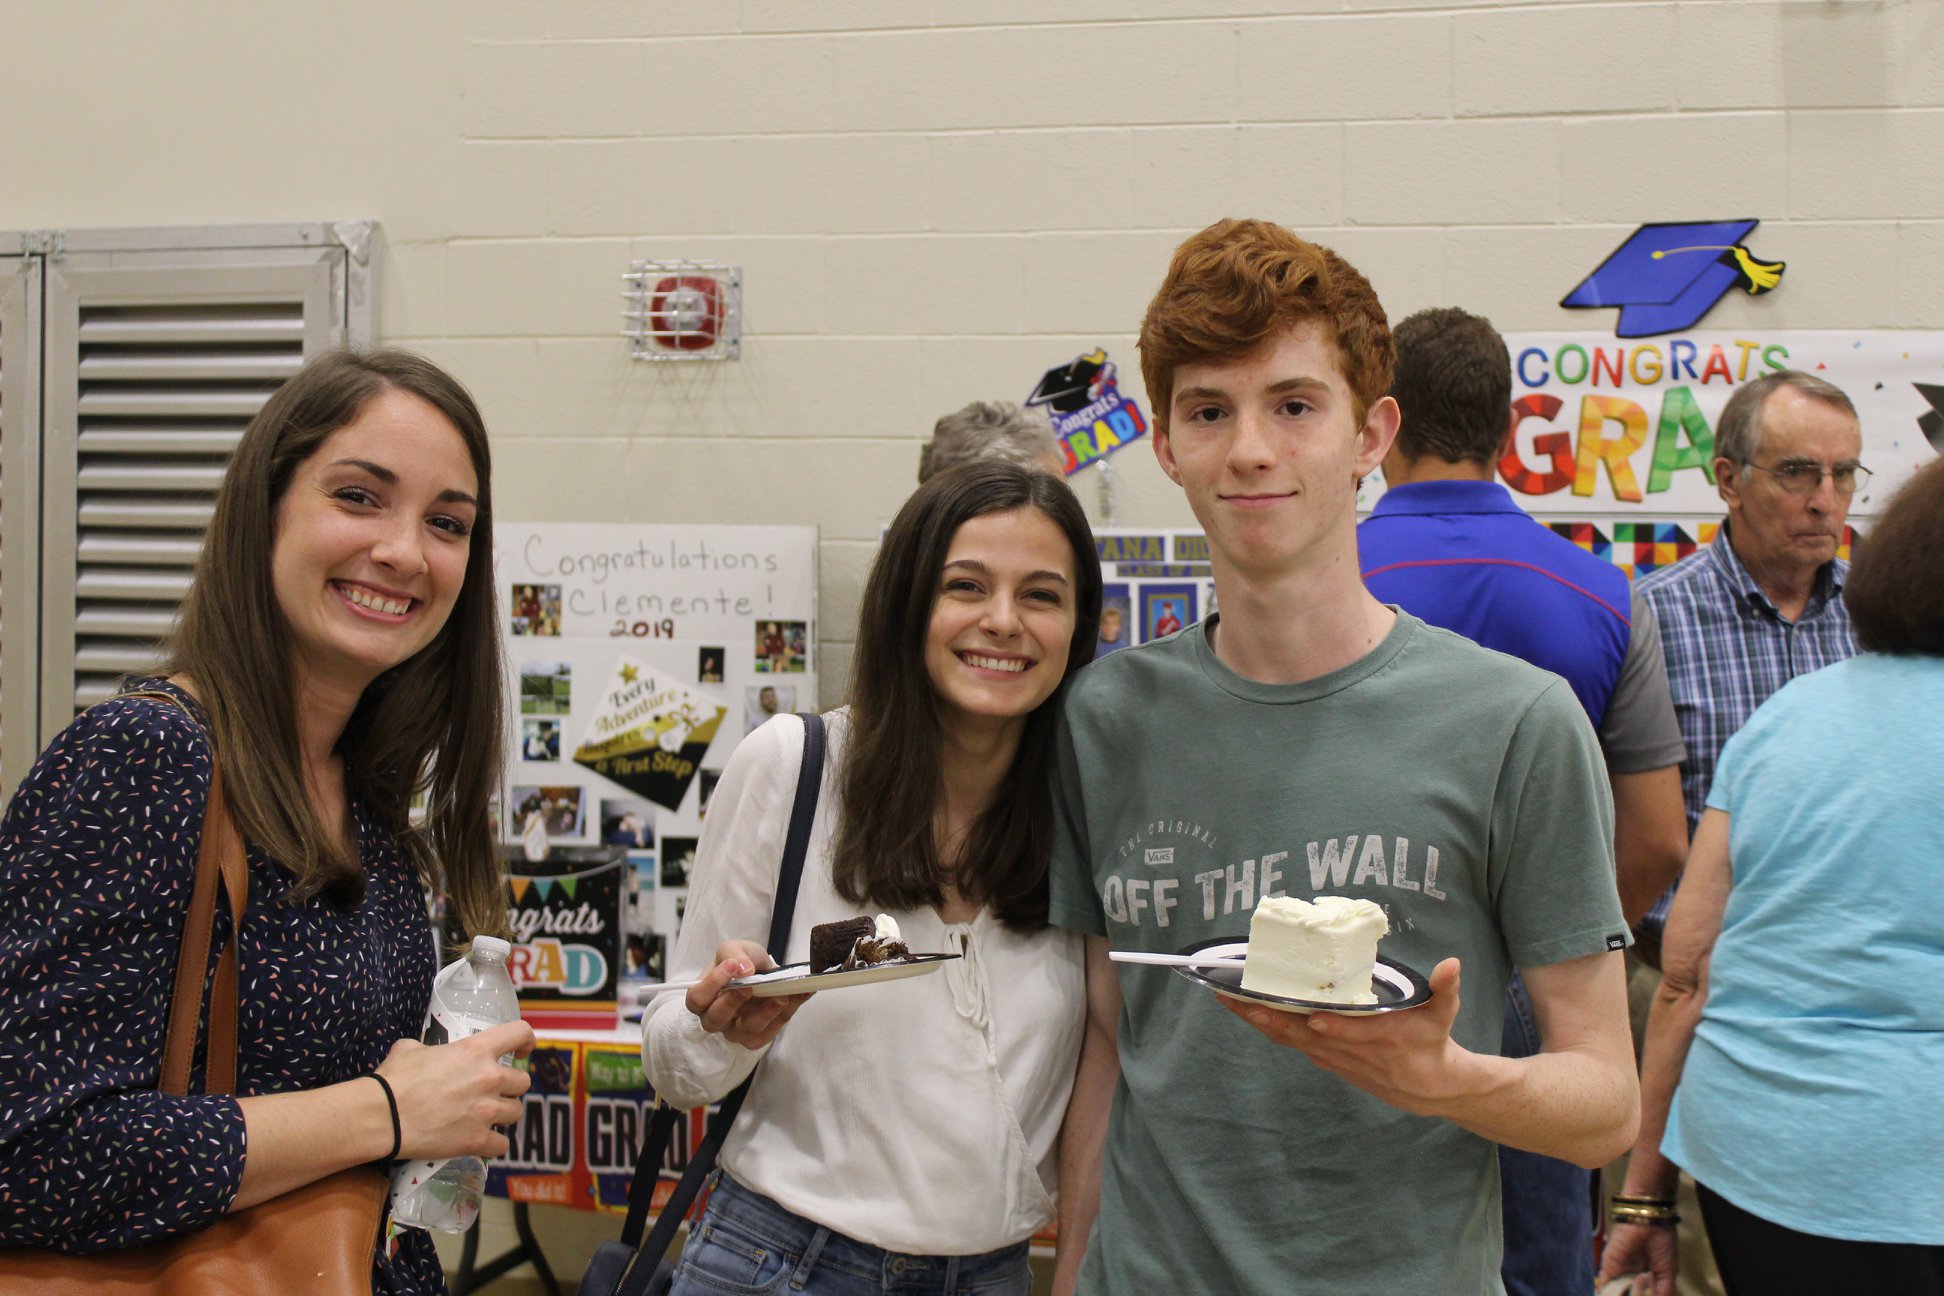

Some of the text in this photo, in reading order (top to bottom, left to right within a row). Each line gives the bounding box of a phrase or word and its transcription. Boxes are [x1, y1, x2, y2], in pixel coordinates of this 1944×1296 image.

[1517, 339, 1791, 388] CONGRATS
[1498, 386, 1717, 503] GRA
[525, 534, 778, 584] Congratulations
[609, 619, 675, 639] 2019
[596, 690, 677, 732] Adventure
[609, 677, 656, 708] Every
[612, 757, 649, 774] First
[653, 751, 692, 778] Step
[1148, 820, 1217, 849] ORIGINAL
[1102, 834, 1447, 928] OFF THE WALL
[505, 901, 605, 943] ngrats
[506, 939, 606, 993] RAD
[586, 1101, 691, 1175] GRD
